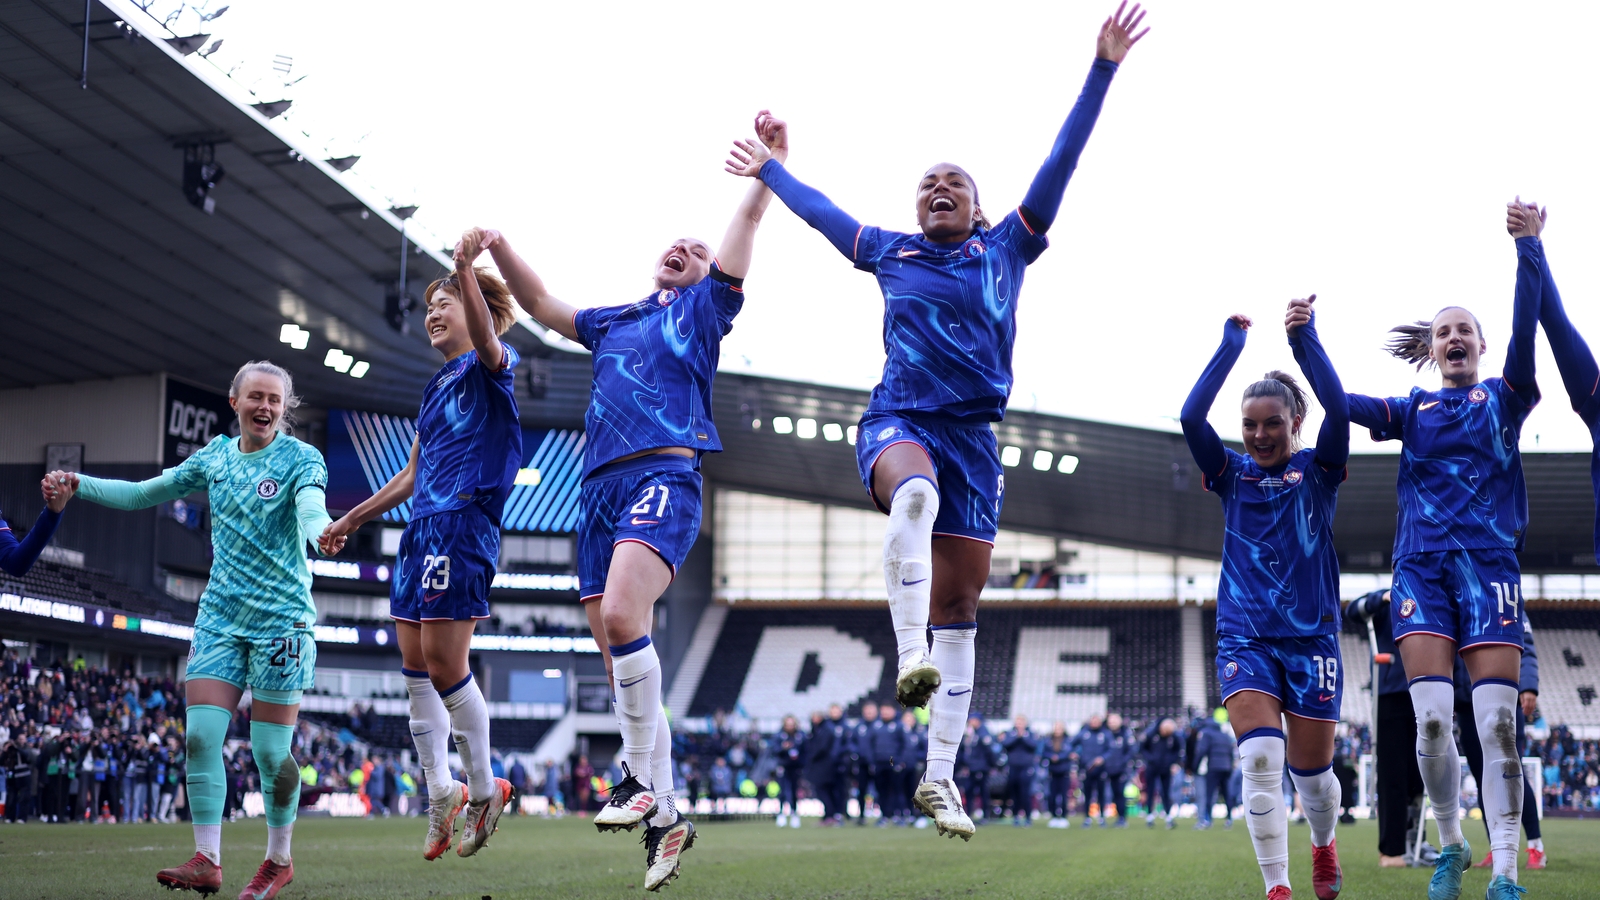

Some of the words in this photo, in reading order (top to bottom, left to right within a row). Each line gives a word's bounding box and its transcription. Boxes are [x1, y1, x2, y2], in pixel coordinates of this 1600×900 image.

[168, 400, 218, 445] DCFC
[630, 484, 669, 518] 21
[421, 554, 450, 590] 23
[1490, 582, 1519, 618] 14
[270, 637, 301, 668] 24
[1313, 655, 1338, 691] 19
